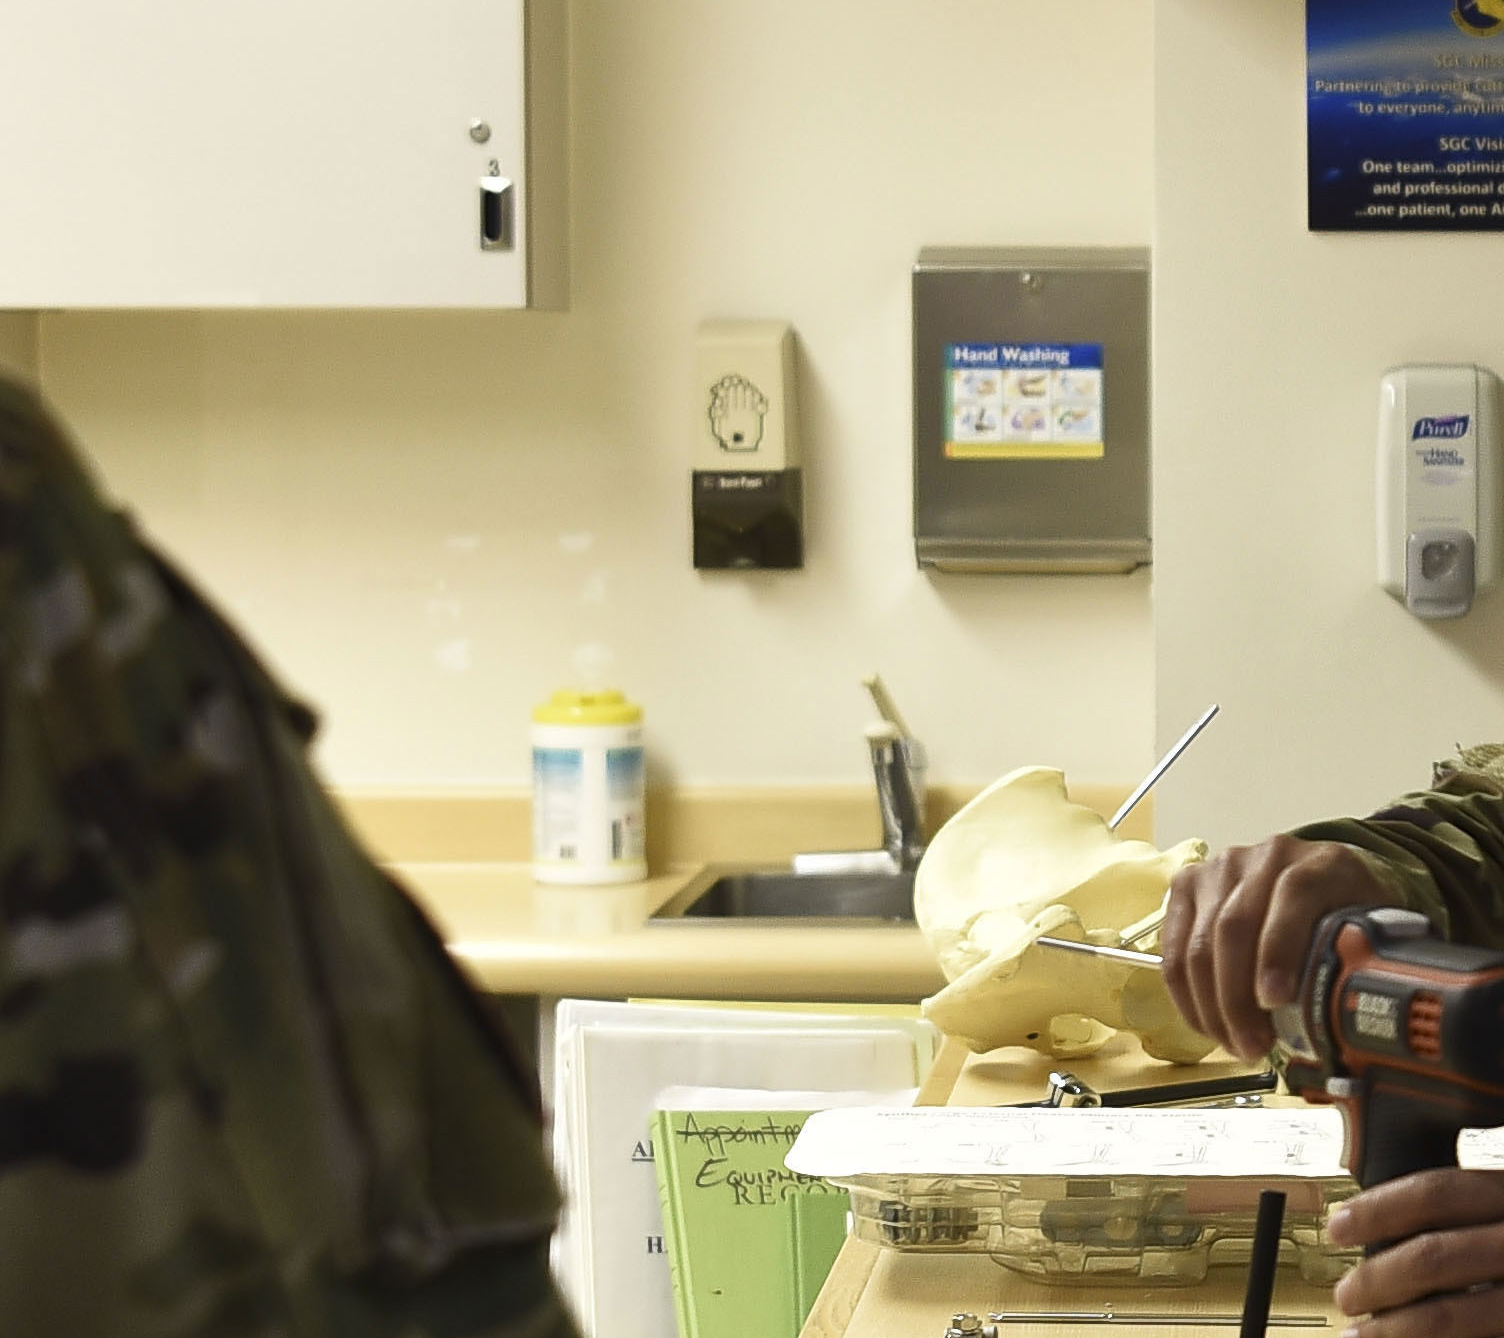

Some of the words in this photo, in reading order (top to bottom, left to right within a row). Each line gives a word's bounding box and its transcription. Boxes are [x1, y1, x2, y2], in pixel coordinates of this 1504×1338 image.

[1316, 79, 1394, 97] Partnering
[1359, 100, 1374, 115] to
[1378, 102, 1450, 117] everyone,
[1439, 137, 1470, 151] SGC
[1362, 160, 1392, 173] One
[1373, 182, 1401, 195] and
[1405, 182, 1494, 197] professional
[1399, 203, 1456, 218] patient,
[1459, 205, 1486, 216] one
[954, 347, 998, 361] Hand
[1001, 347, 1070, 365] Washing
